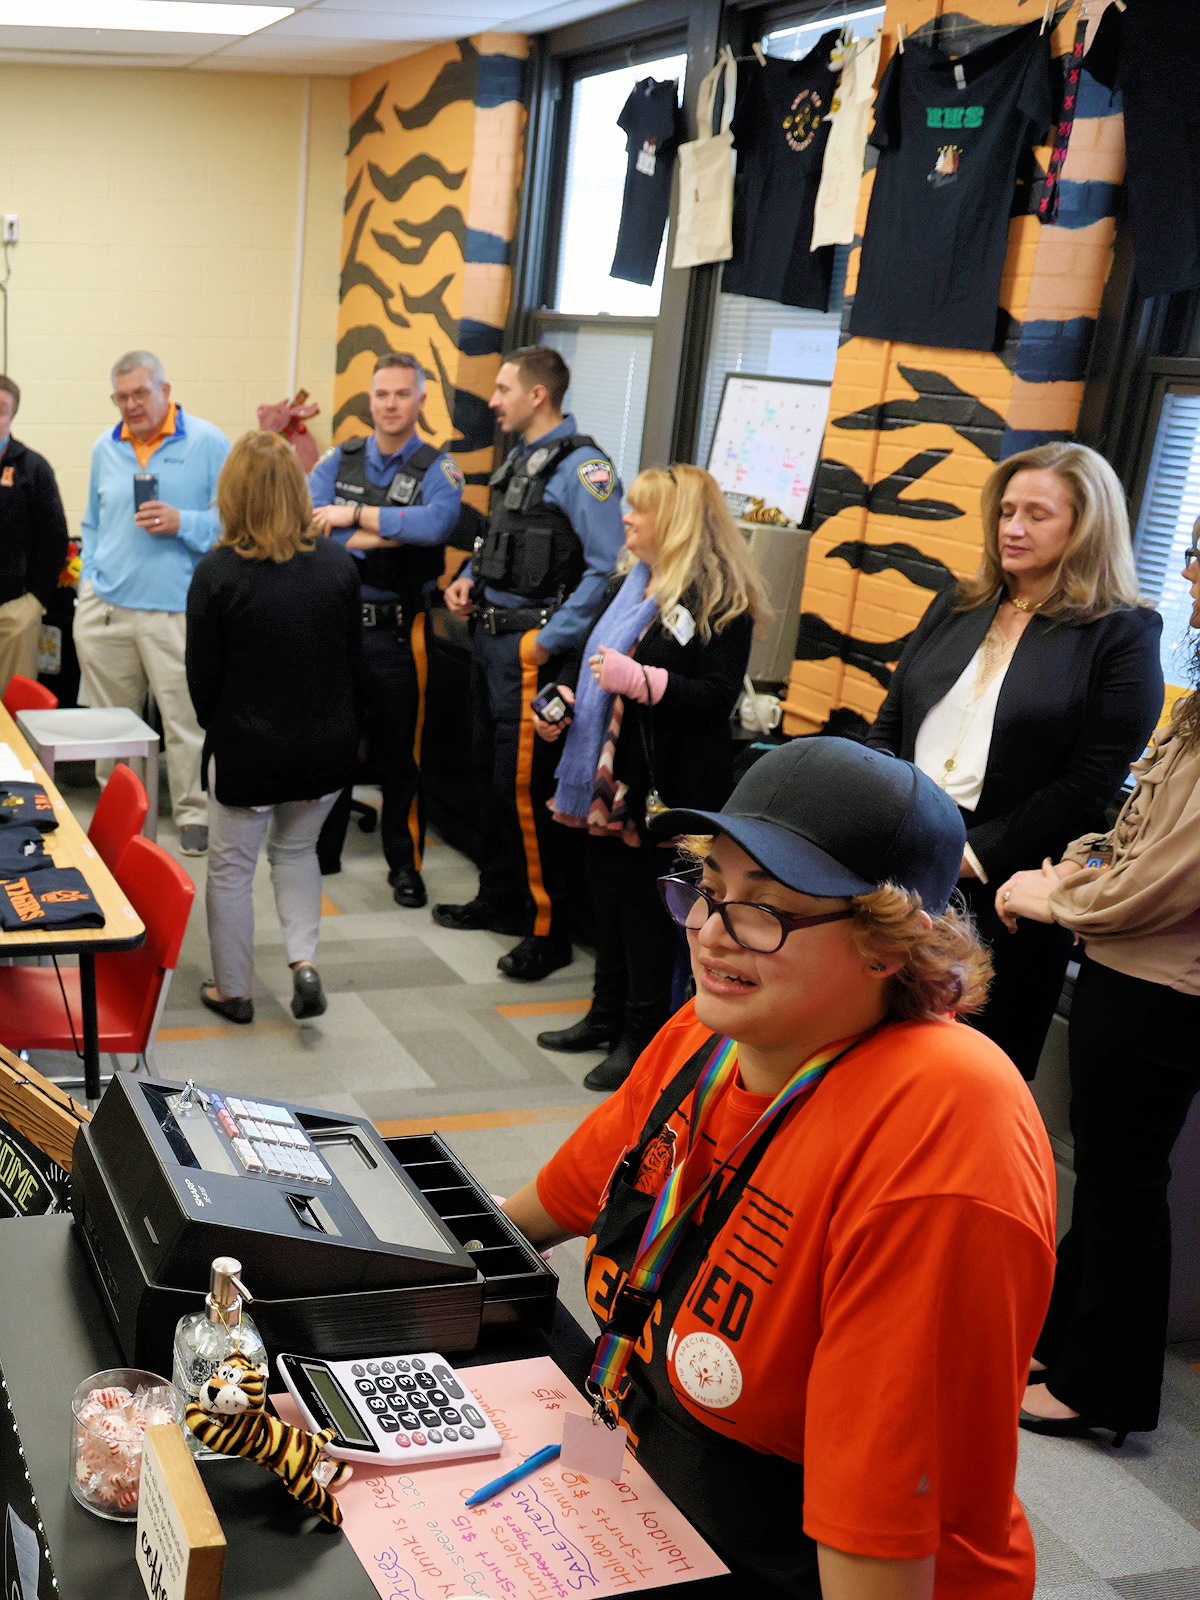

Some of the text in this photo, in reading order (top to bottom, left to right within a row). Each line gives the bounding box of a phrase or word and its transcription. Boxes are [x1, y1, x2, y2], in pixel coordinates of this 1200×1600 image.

[4, 877, 46, 922] TIGERS
[185, 1178, 205, 1208] SHARP
[379, 1378, 394, 1388] 6
[399, 1376, 414, 1387] 3
[679, 1337, 711, 1358] SPECIAL
[714, 1342, 738, 1394] OLYMPICS
[360, 1381, 396, 1428] 7 8 9
[390, 1397, 406, 1406] 5
[410, 1393, 426, 1404] 2
[532, 1389, 560, 1410] $15
[679, 1367, 729, 1406] PLAY UNIFIED
[402, 1414, 417, 1424] 4
[444, 1410, 458, 1418] 0
[365, 1477, 392, 1509] free
[394, 1474, 426, 1510] $20
[539, 1477, 578, 1517] Smiles
[560, 1473, 590, 1498] $10
[392, 1518, 409, 1531] is
[509, 1490, 598, 1590] SALE ITEMS
[592, 1508, 653, 1578] T-shirts
[637, 1512, 694, 1573] Holiday
[141, 1530, 168, 1600] coffe
[403, 1535, 442, 1576] drink
[451, 1516, 516, 1600] -shirt $15
[491, 1526, 553, 1600] Tumblers
[585, 1534, 636, 1590] Holiday
